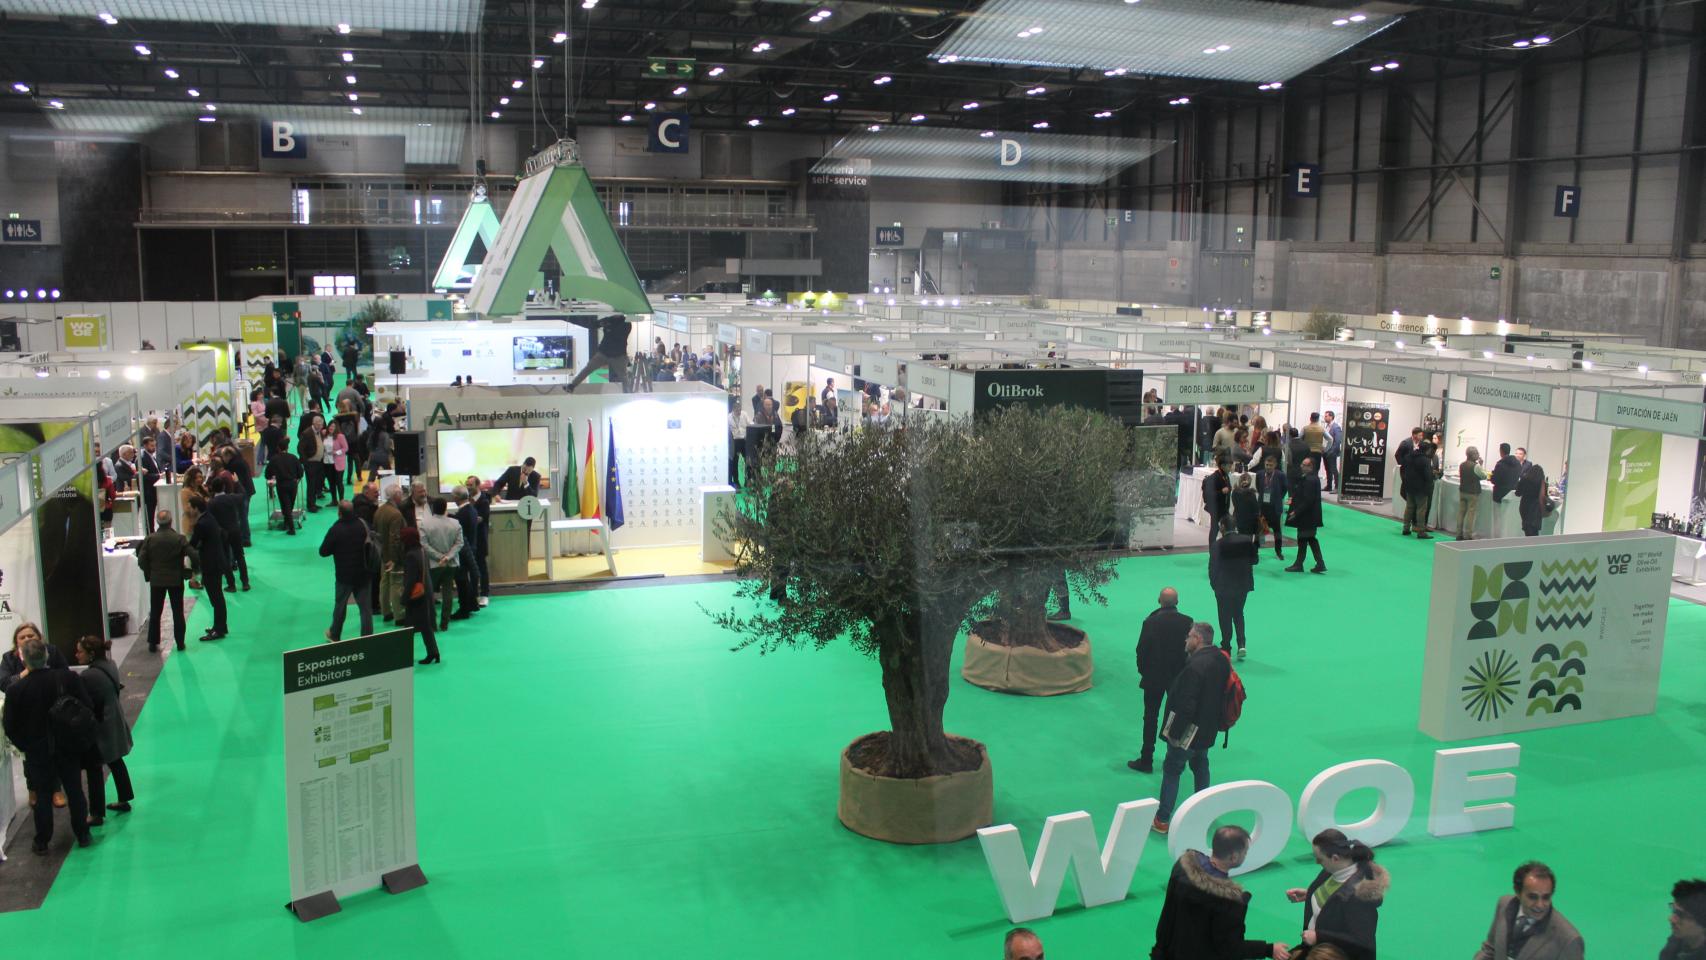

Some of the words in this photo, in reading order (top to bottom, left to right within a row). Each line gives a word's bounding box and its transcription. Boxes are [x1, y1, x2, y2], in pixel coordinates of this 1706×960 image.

[272, 121, 296, 153] B
[657, 118, 681, 148] C
[1000, 139, 1022, 166] D
[1298, 168, 1310, 192] E
[1561, 190, 1574, 214] F
[70, 322, 94, 330] WO
[73, 329, 92, 337] OE
[988, 382, 1044, 397] OliBrok
[1179, 385, 1192, 394] ORO
[1193, 385, 1203, 393] DEL
[1502, 390, 1520, 399] OLIVAR
[455, 413, 487, 423] Junta
[490, 411, 503, 421] de
[505, 408, 560, 419] Andalucía
[1617, 405, 1652, 418] DIPUTACIÓN
[1653, 410, 1661, 420] DE
[1661, 411, 1679, 423] JAÉN
[1607, 553, 1632, 564] WO
[1608, 564, 1629, 575] OE
[297, 652, 365, 673] Expositores
[297, 669, 352, 687] Exhibitors
[976, 742, 1521, 924] WOOE
